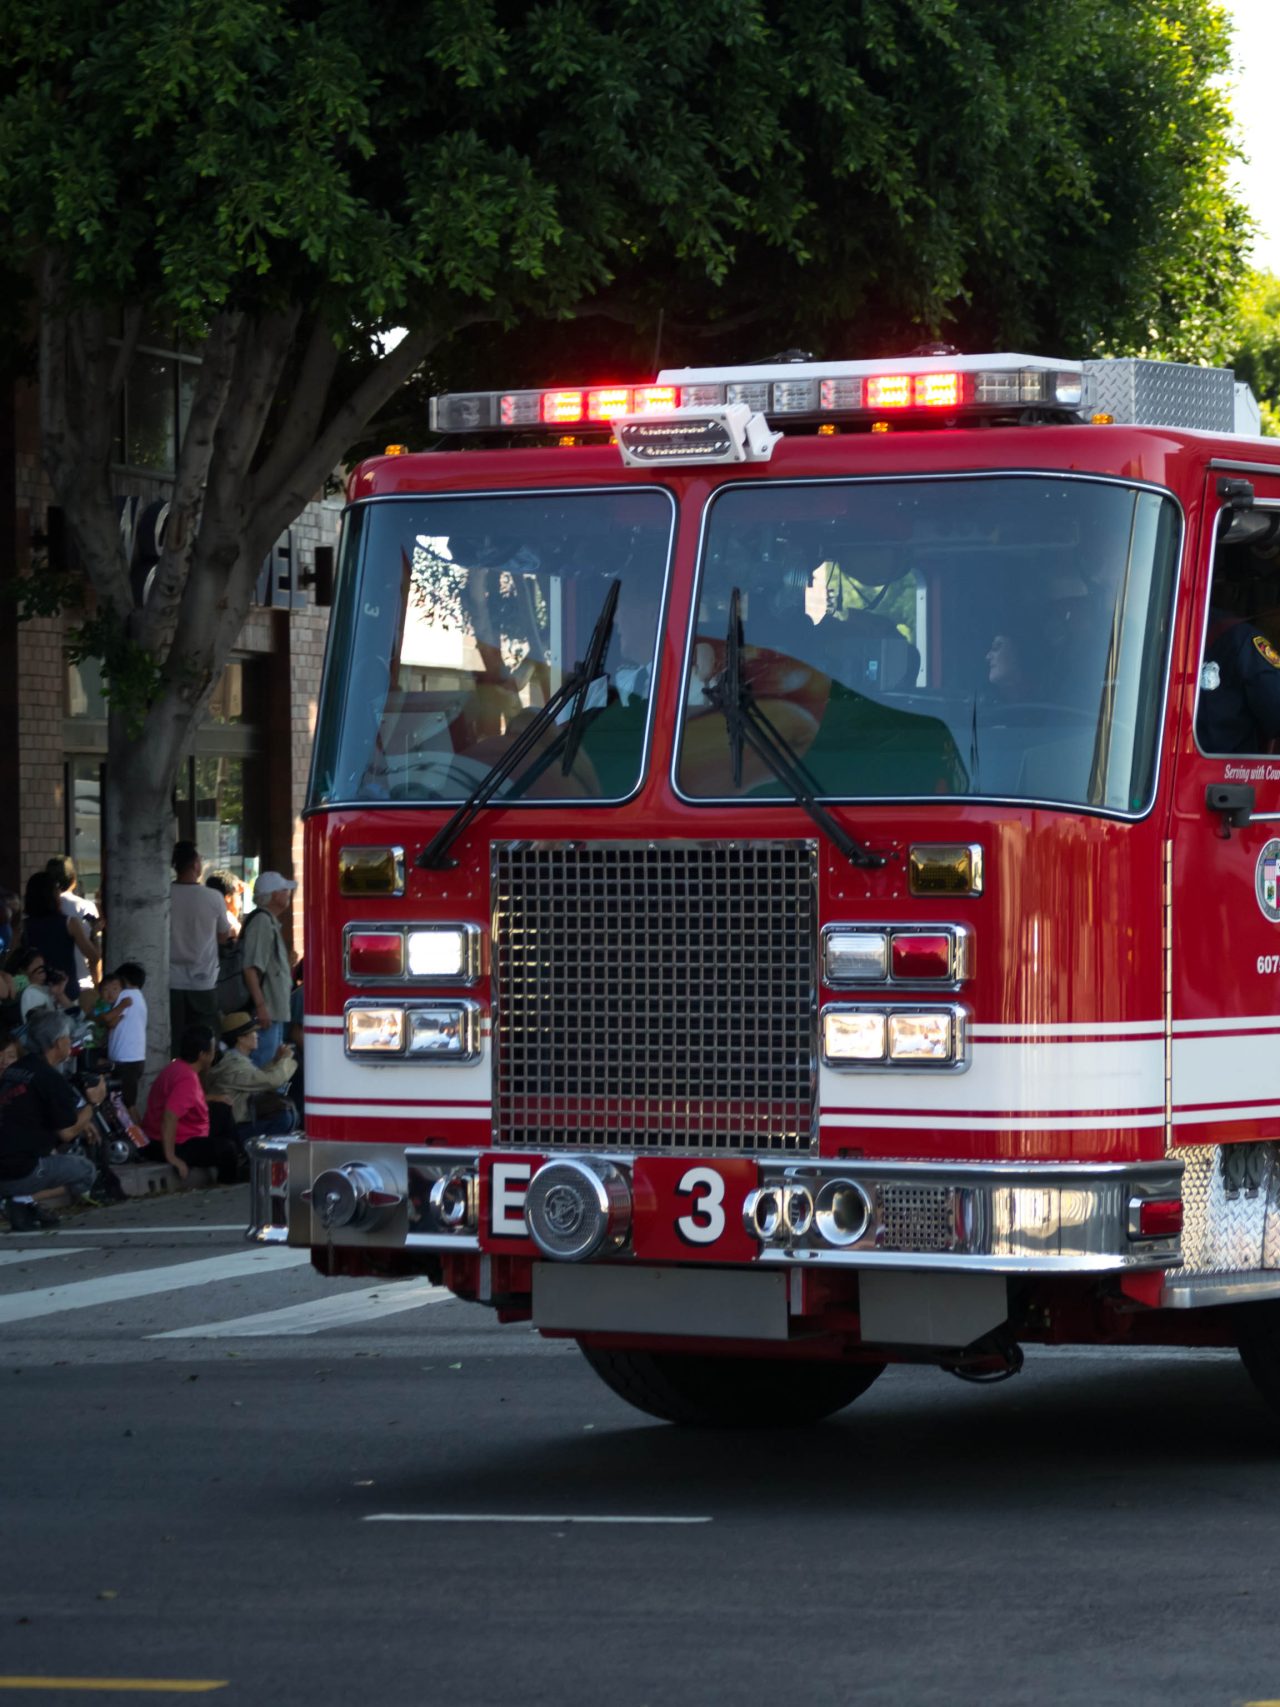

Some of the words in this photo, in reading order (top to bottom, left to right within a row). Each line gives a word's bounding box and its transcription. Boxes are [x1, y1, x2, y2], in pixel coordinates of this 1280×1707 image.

[1223, 763, 1250, 782] Serving
[1250, 765, 1265, 780] with
[488, 1162, 531, 1240] E
[674, 1167, 727, 1245] 3
